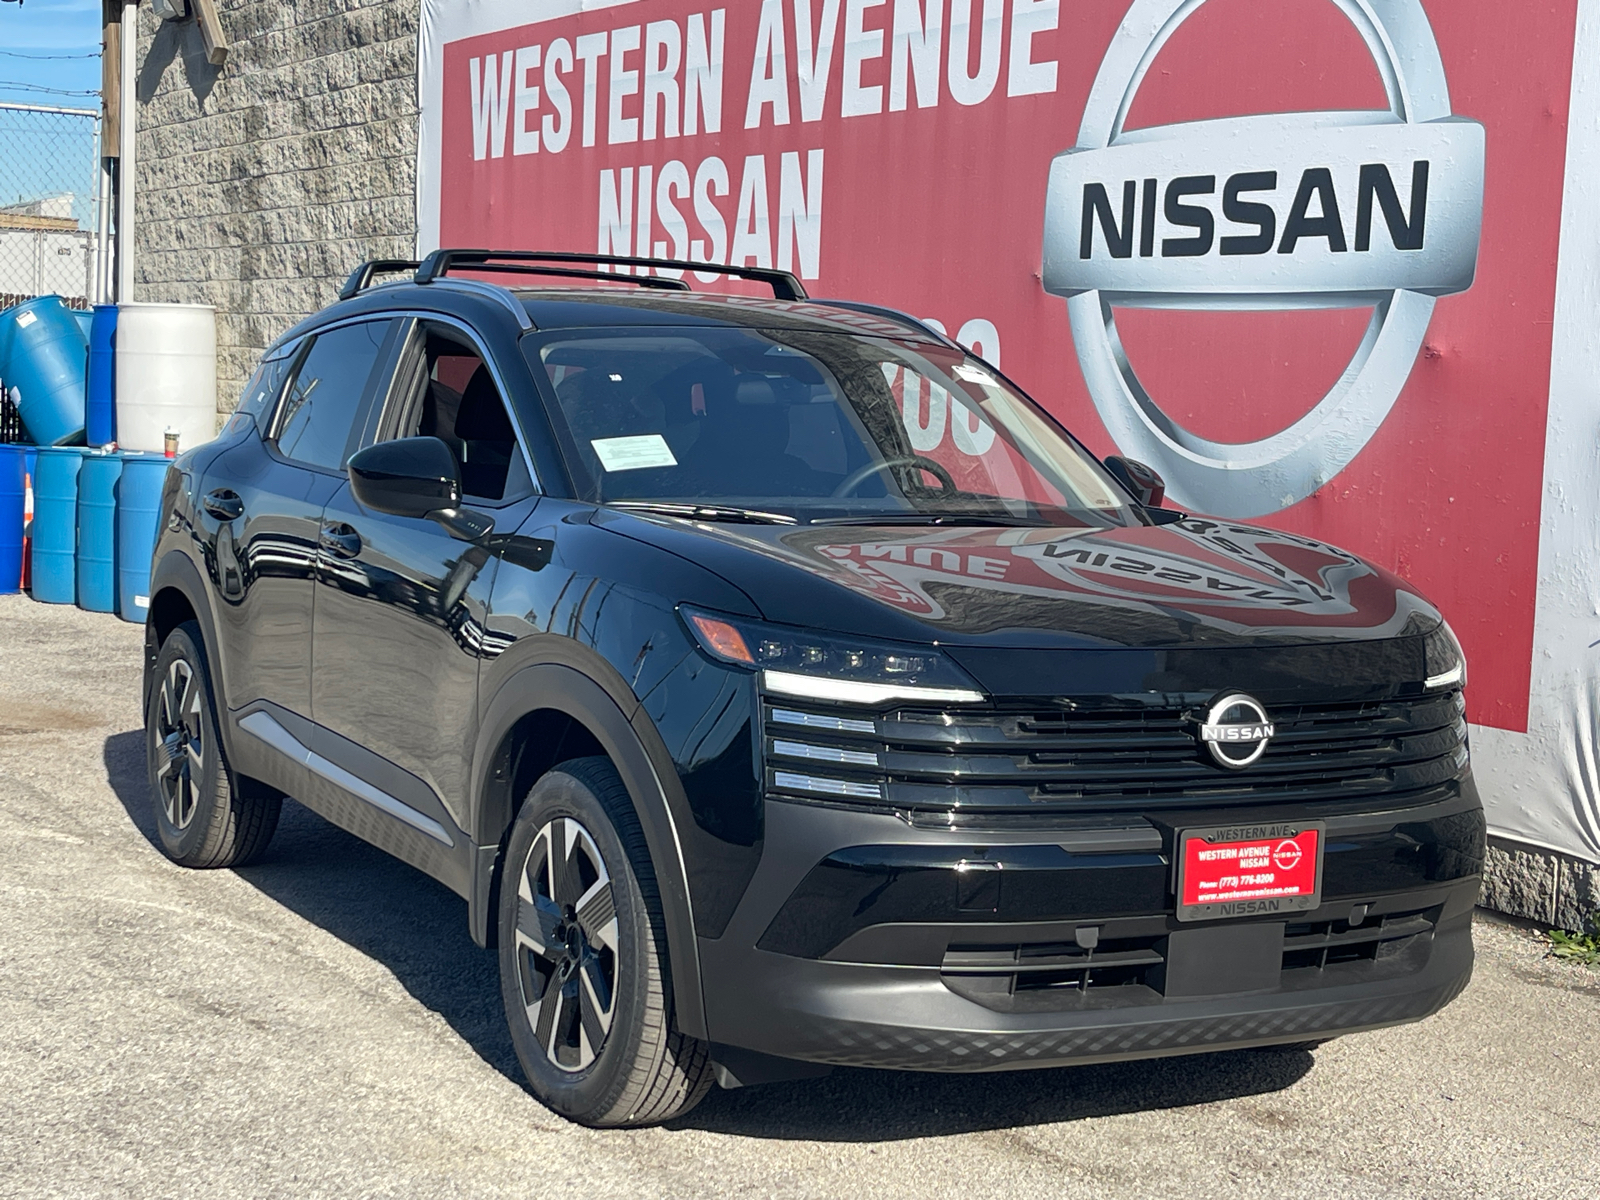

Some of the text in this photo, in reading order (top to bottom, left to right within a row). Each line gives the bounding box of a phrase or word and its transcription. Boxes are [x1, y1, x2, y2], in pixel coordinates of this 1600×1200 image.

[469, 0, 1060, 162] WESTERN AVENUE
[597, 148, 825, 284] NISSAN
[1079, 160, 1430, 260] NISSAN
[881, 318, 1000, 456] 00
[1203, 724, 1274, 741] NISSAN
[1216, 826, 1267, 841] WESTERN
[1198, 846, 1270, 861] WESTERN AVENUE
[1273, 851, 1302, 859] NISSAN
[1240, 857, 1270, 869] NISSAN
[1219, 876, 1239, 889] (773)
[1220, 900, 1280, 915] NISSAN
